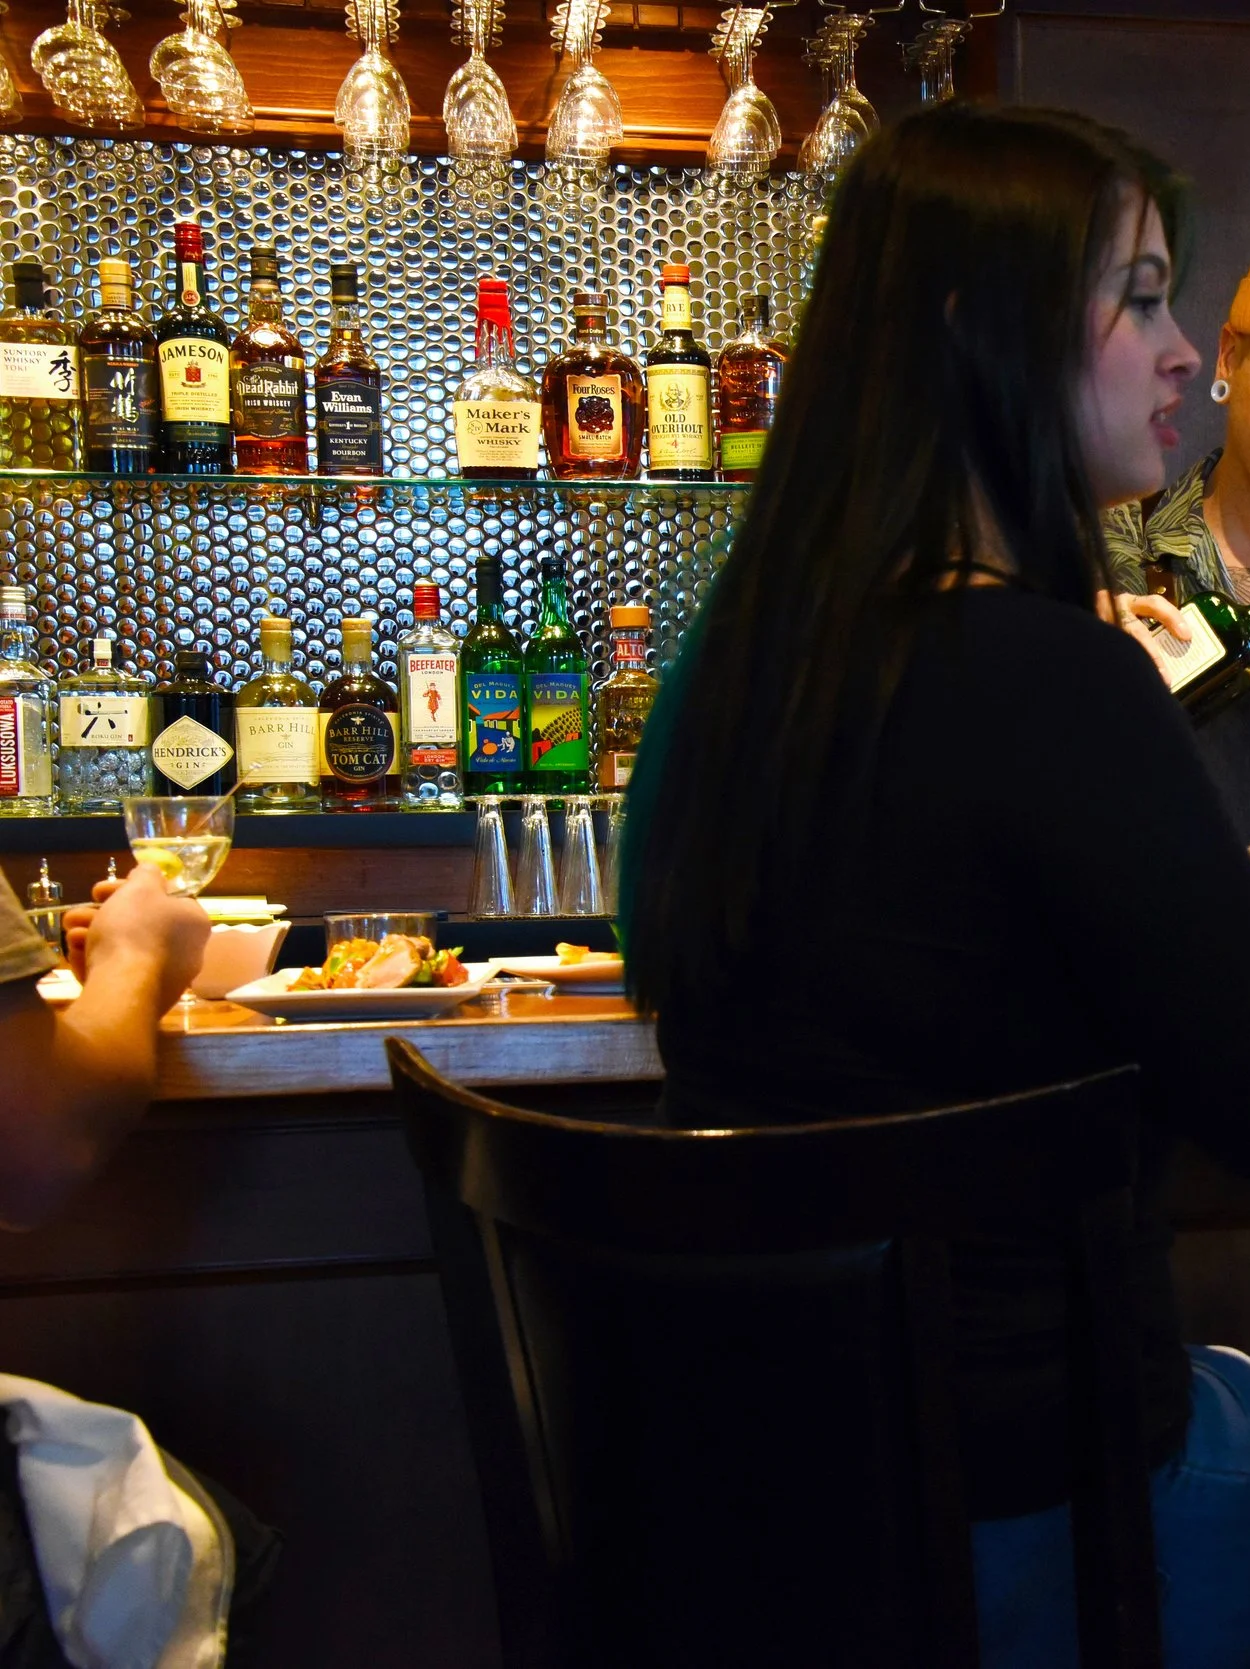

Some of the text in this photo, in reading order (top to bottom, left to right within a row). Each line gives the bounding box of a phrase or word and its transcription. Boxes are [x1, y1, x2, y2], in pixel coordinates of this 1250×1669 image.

[666, 303, 685, 312] RYE
[4, 356, 41, 364] WHISKY
[161, 345, 224, 364] JAMESON
[48, 350, 77, 392] 季
[236, 379, 299, 398] Dead Rabbit
[572, 384, 615, 395] Four Roses
[331, 391, 362, 402] Evan
[322, 401, 373, 414] Williams
[466, 408, 531, 420] Maker's
[664, 413, 686, 423] OLD
[486, 422, 530, 433] Mark
[651, 424, 704, 434] OVERHOLT
[671, 439, 678, 448] 4
[617, 643, 644, 657] ALTO
[409, 659, 455, 673] BEEFEATER
[474, 681, 486, 689] DEL
[471, 690, 518, 699] VIDA
[533, 690, 580, 699] VIDA
[249, 722, 316, 735] BARR HILL
[329, 726, 389, 738] BARR HILL
[0, 713, 17, 785] LUKSUSOWA
[154, 746, 227, 758] HENDRICK'S
[332, 753, 388, 765] TOM CAT
